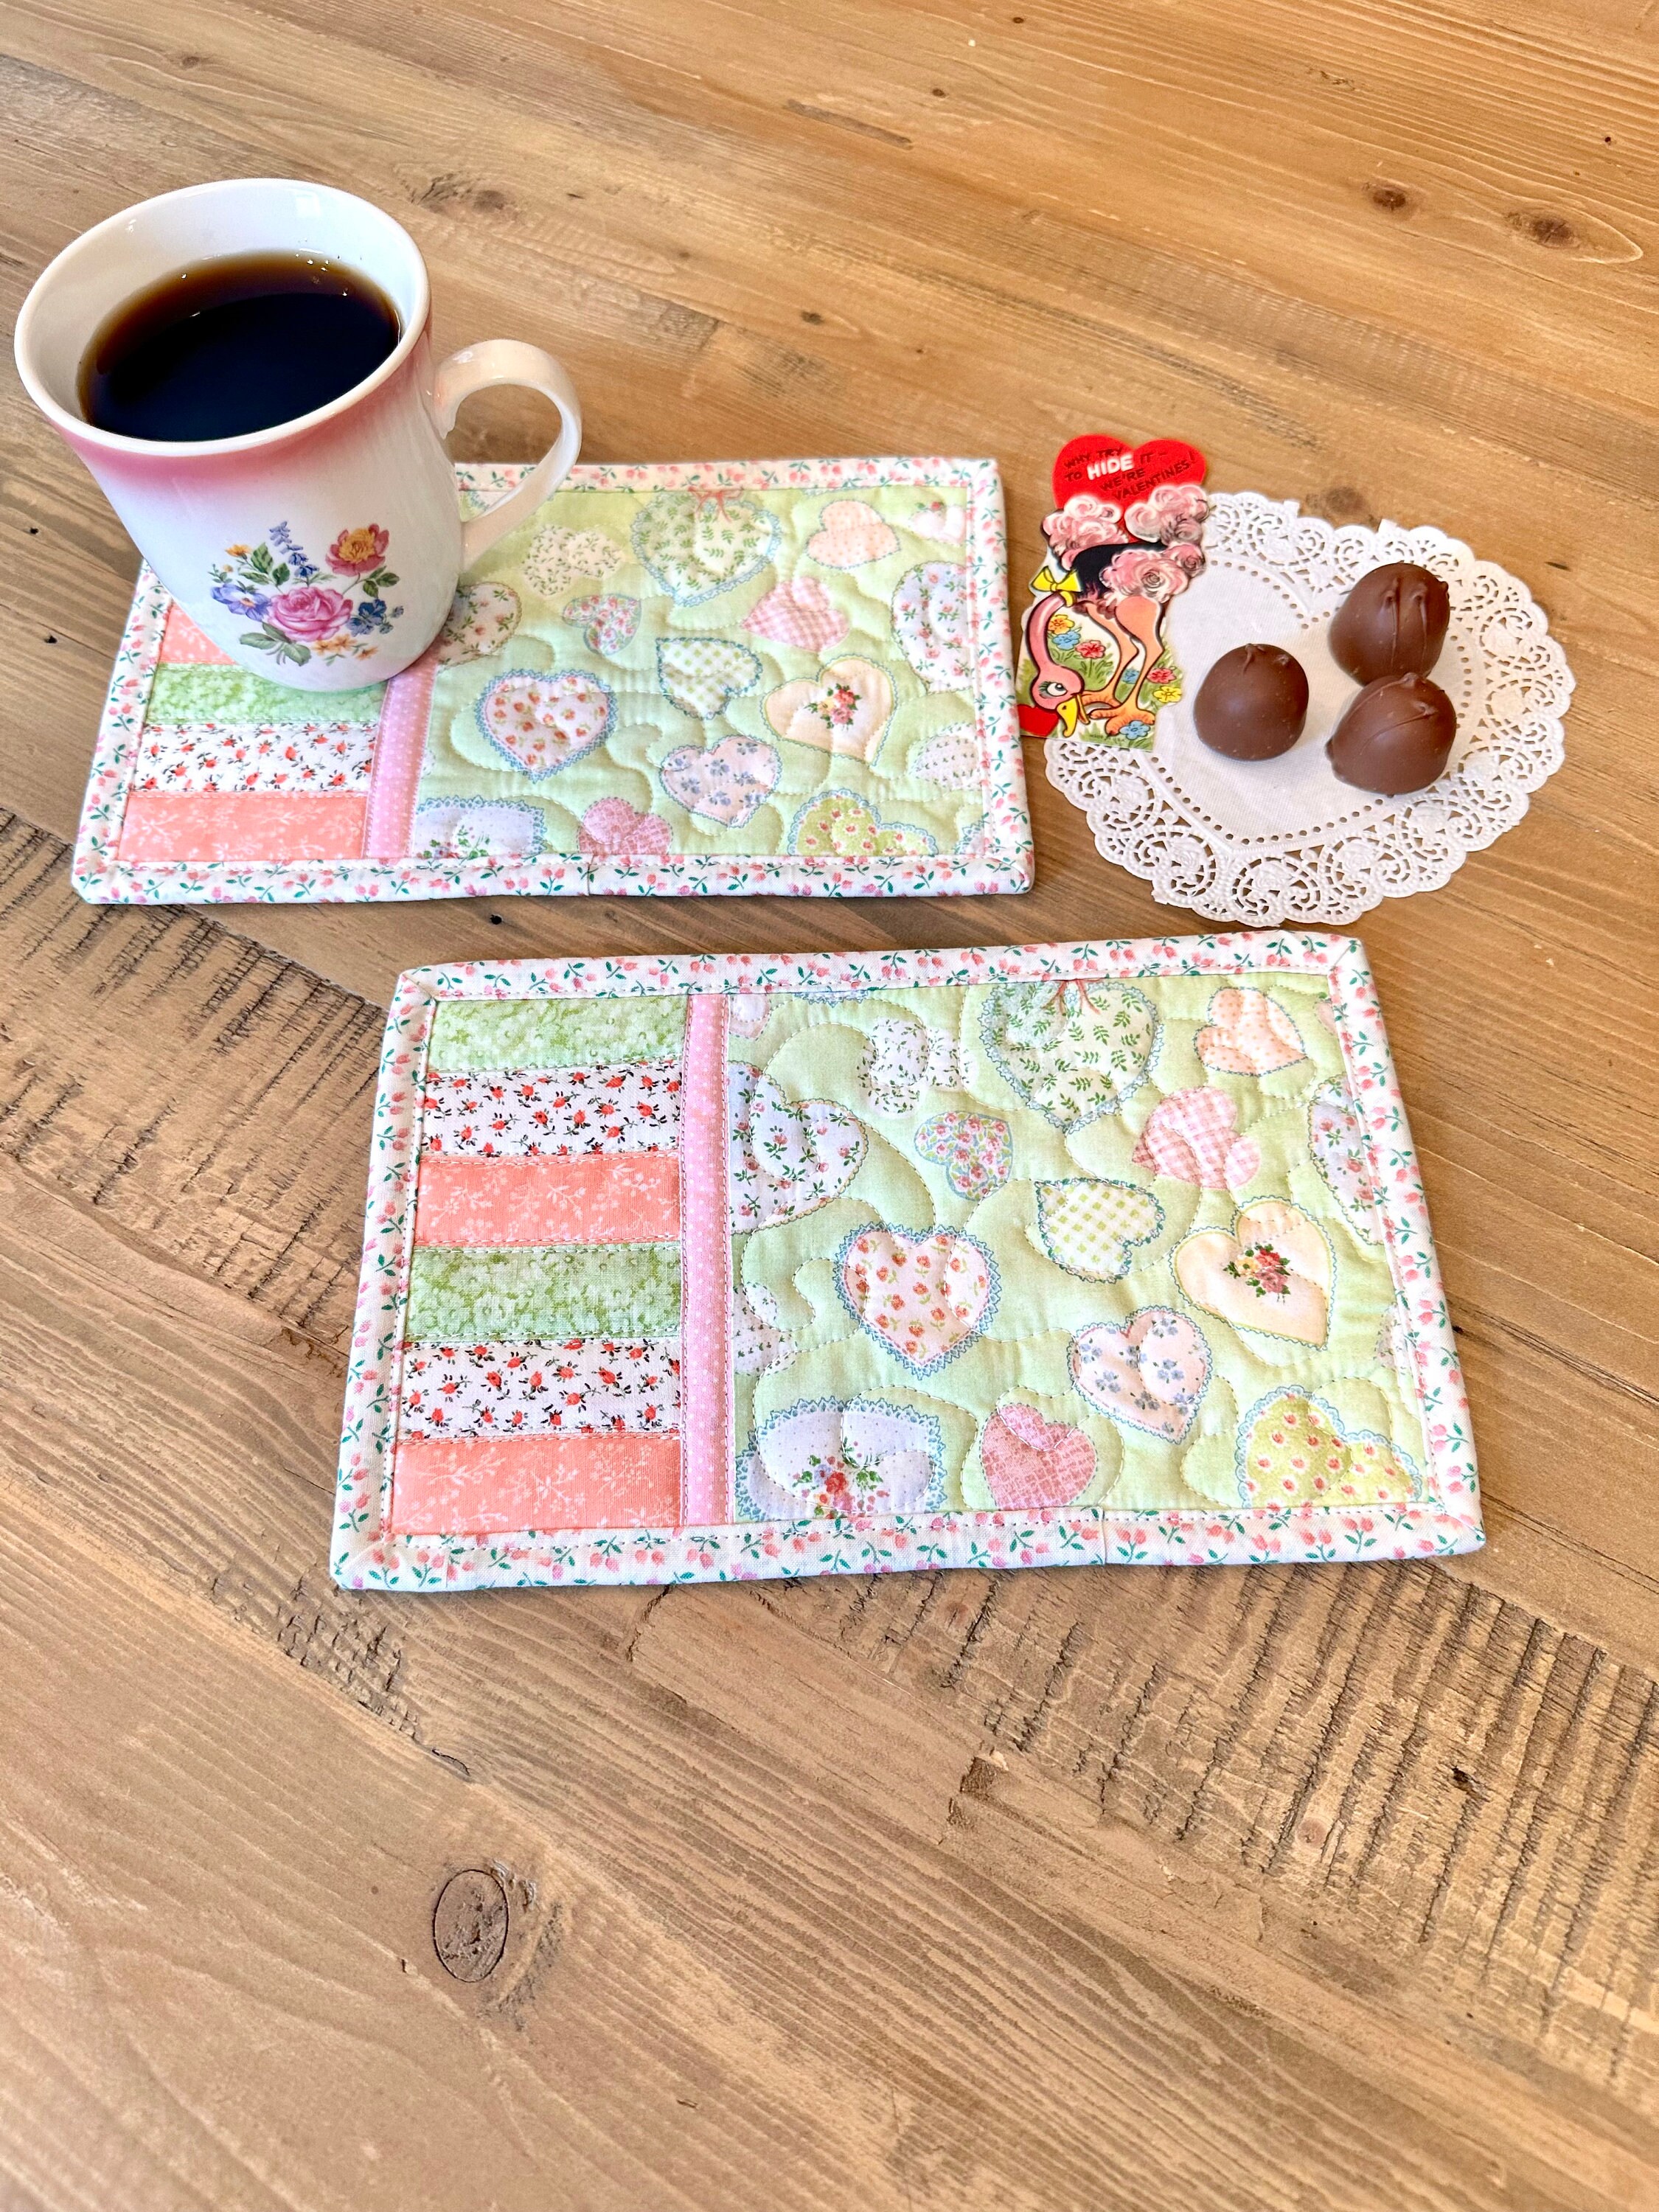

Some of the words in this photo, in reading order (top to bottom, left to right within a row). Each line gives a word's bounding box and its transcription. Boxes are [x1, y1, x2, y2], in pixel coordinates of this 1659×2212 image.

[1064, 453, 1091, 468] WHY
[1097, 446, 1123, 457] TRY
[1064, 471, 1082, 482] TO
[1086, 453, 1135, 480] HIDE
[1140, 453, 1154, 465] IT
[1099, 467, 1146, 491] WE'RE
[1112, 450, 1197, 501] VALENTINES!
